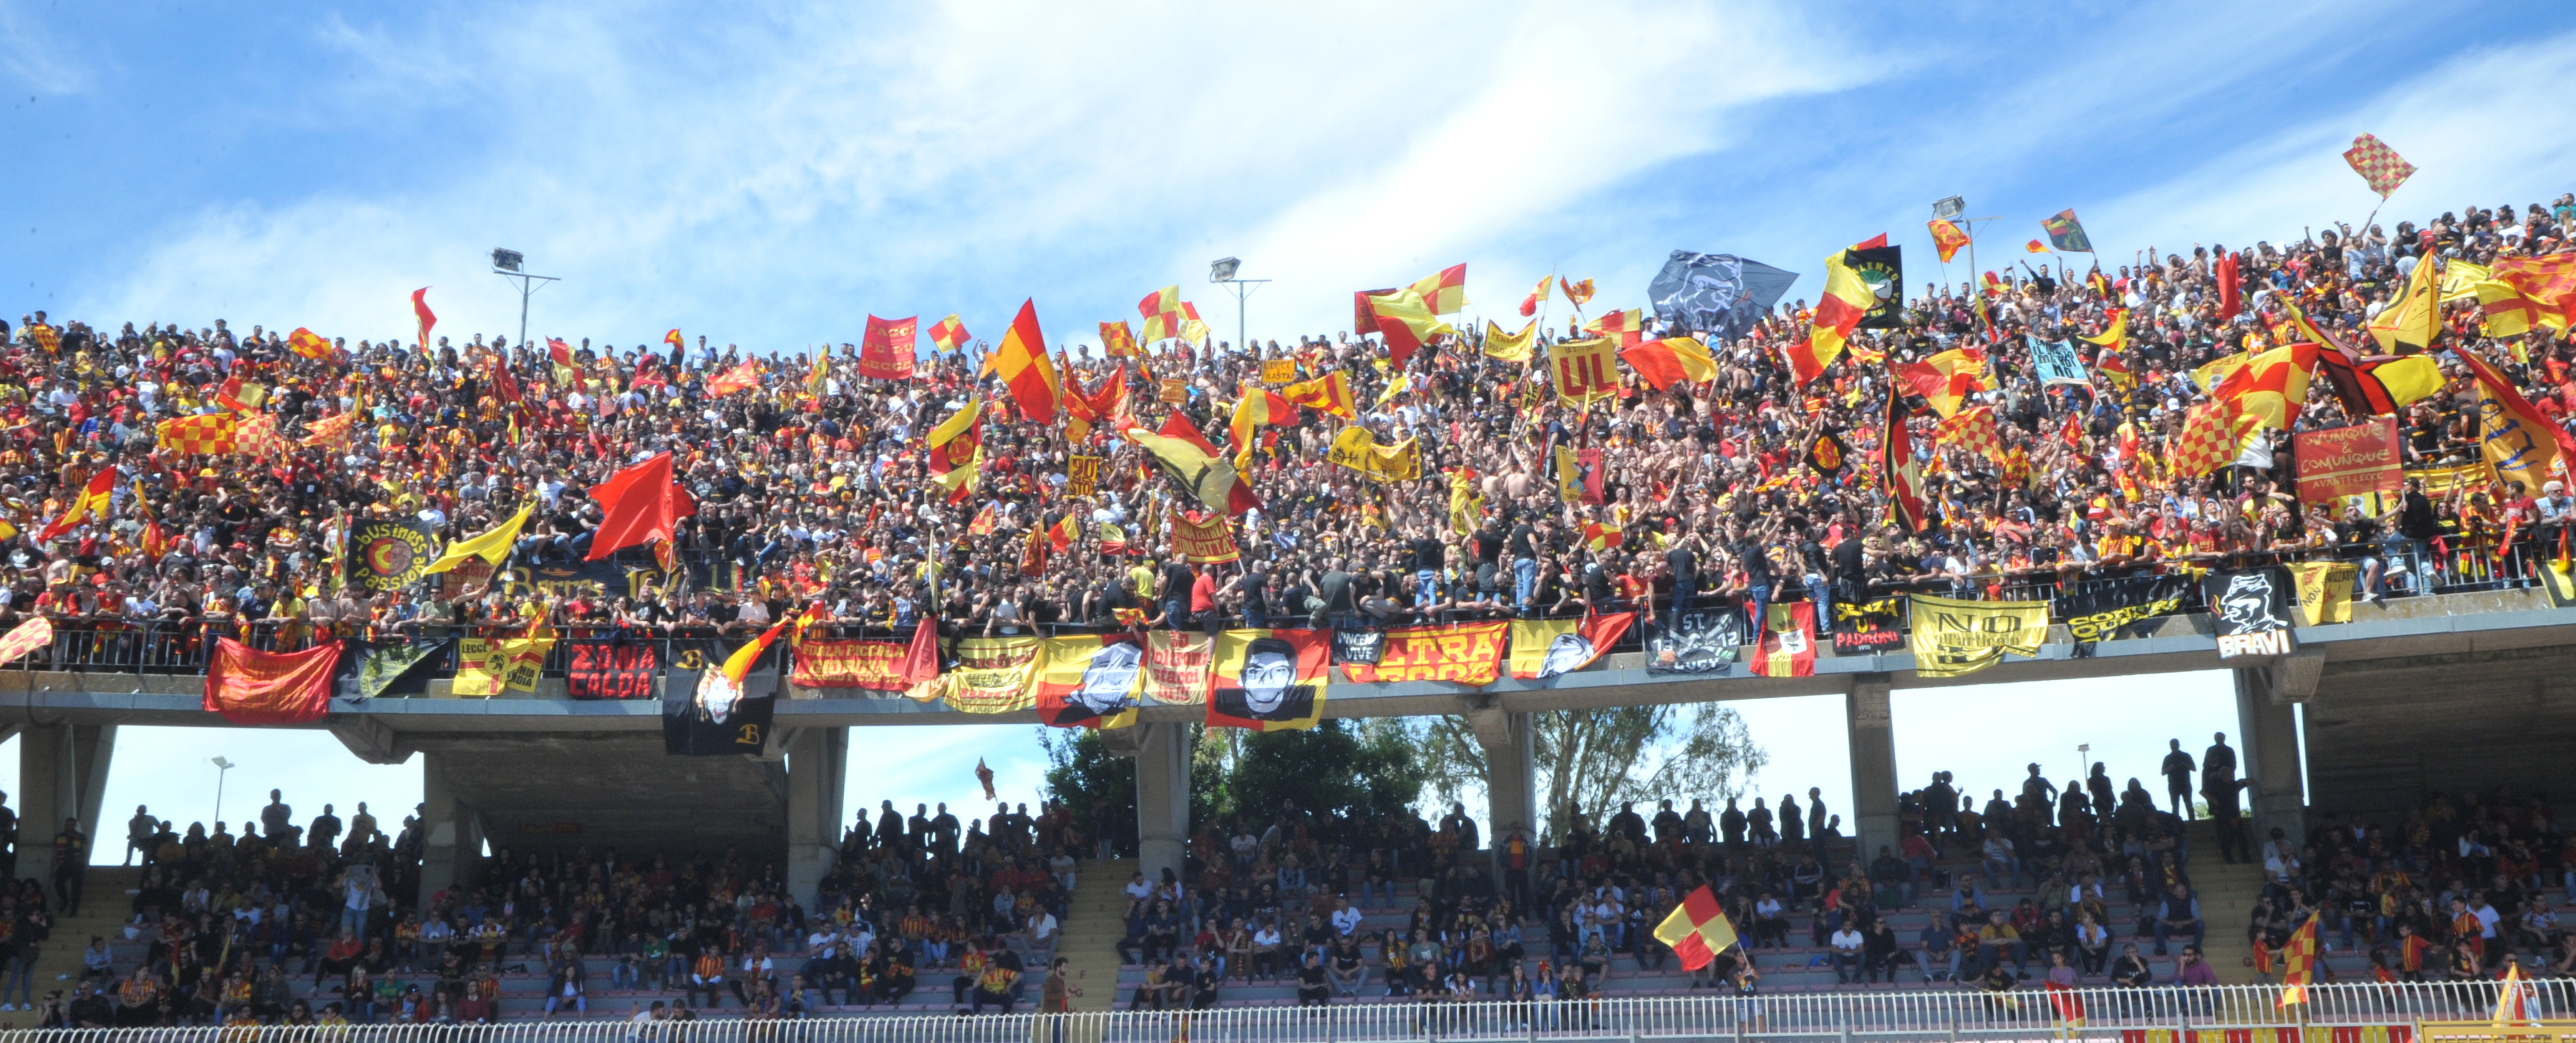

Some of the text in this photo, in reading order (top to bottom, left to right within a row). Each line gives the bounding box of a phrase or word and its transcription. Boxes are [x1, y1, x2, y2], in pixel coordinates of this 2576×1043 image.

[1559, 353, 1619, 397] UL
[2301, 423, 2386, 446] OVUNQUE
[2301, 449, 2391, 473] COMUNQUE
[2313, 476, 2350, 489] AVANTI
[2301, 586, 2322, 607] NON
[1835, 598, 1898, 622] SENZA
[1935, 611, 2022, 634] NO
[462, 644, 488, 654] LECCE
[802, 643, 906, 658] FORZA PICCOLA
[1718, 631, 1740, 647] 12
[1836, 630, 1899, 649] PADRONI
[2216, 629, 2291, 659] BRAVI
[571, 643, 656, 671] ZONA
[1345, 647, 1374, 661] VIVE
[568, 671, 651, 698] CALDA
